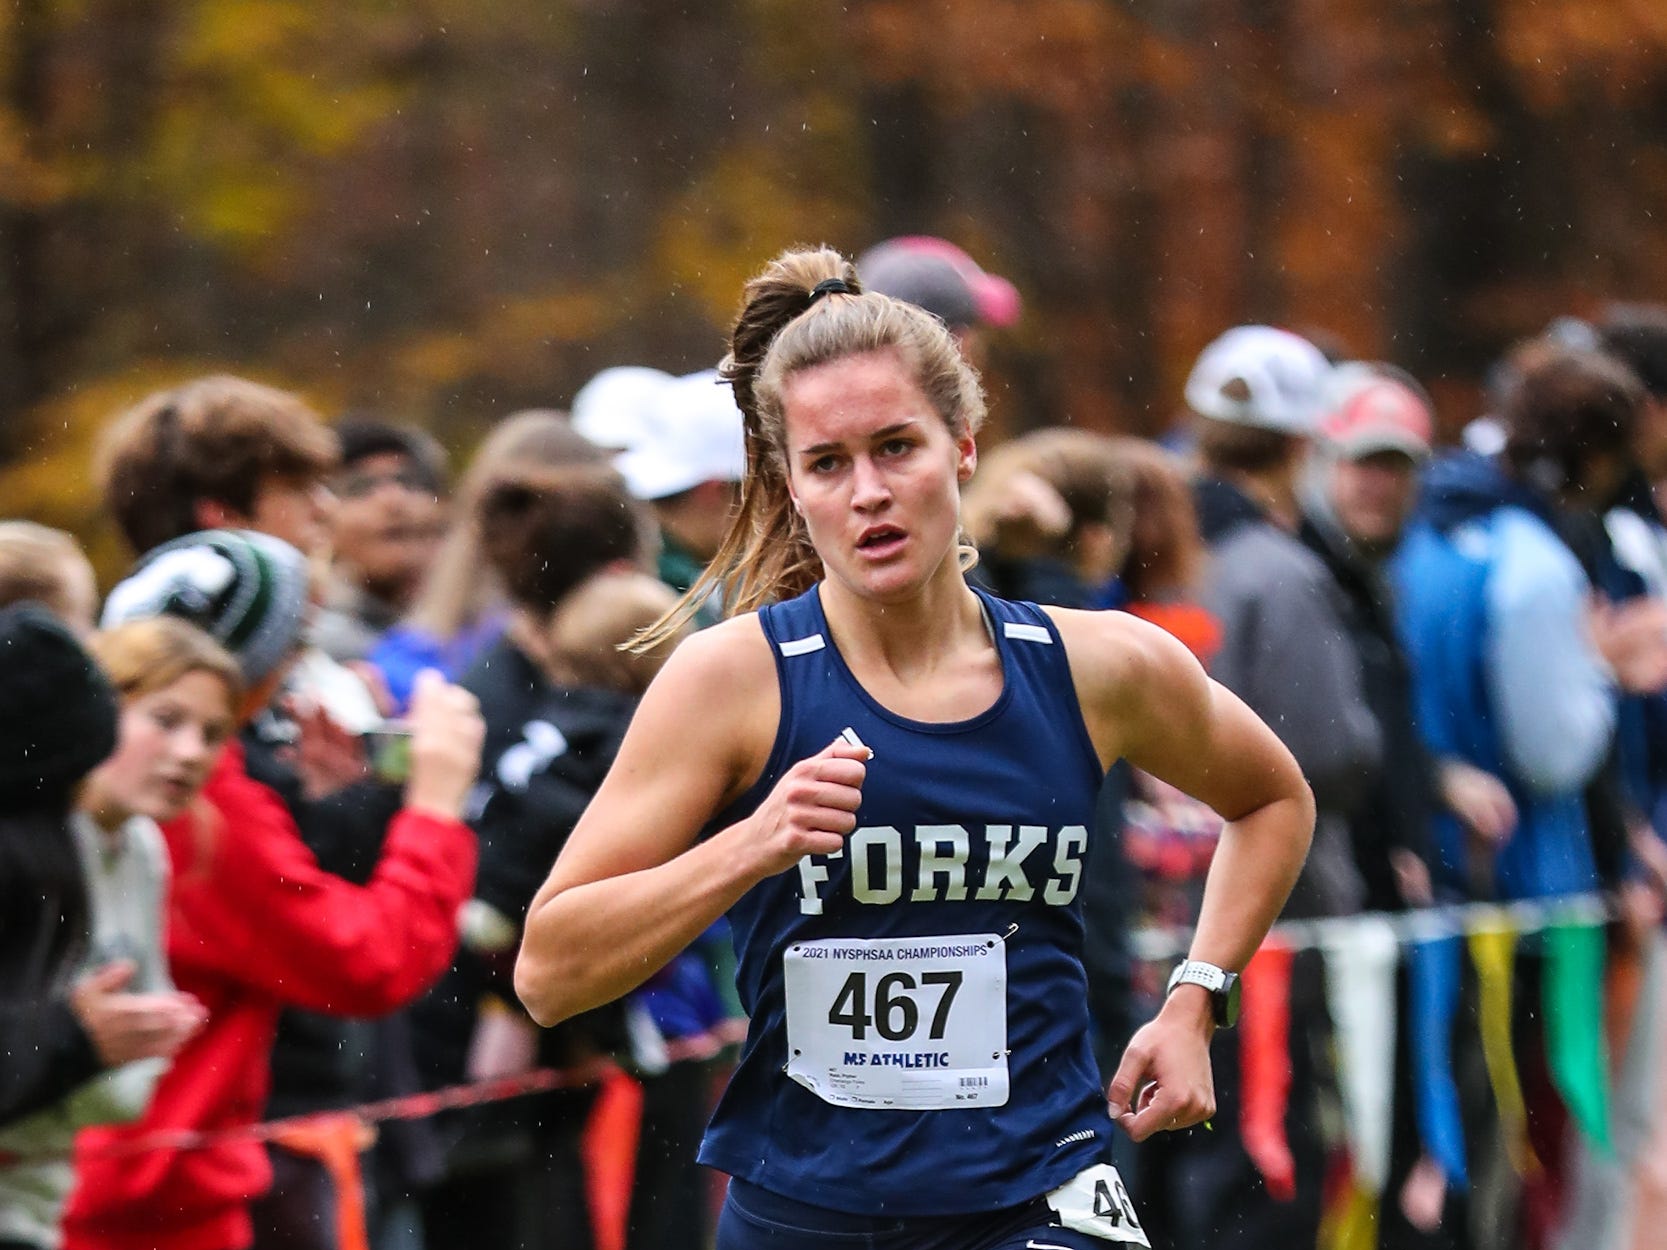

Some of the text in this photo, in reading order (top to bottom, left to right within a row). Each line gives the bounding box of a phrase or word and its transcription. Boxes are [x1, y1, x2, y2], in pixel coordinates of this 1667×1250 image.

[799, 824, 1088, 915] FORKS
[802, 944, 988, 960] 2021 NYSPHSAA CHAMPIONSHIPS
[828, 971, 963, 1041] 467
[870, 1052, 949, 1068] ATHLETIC
